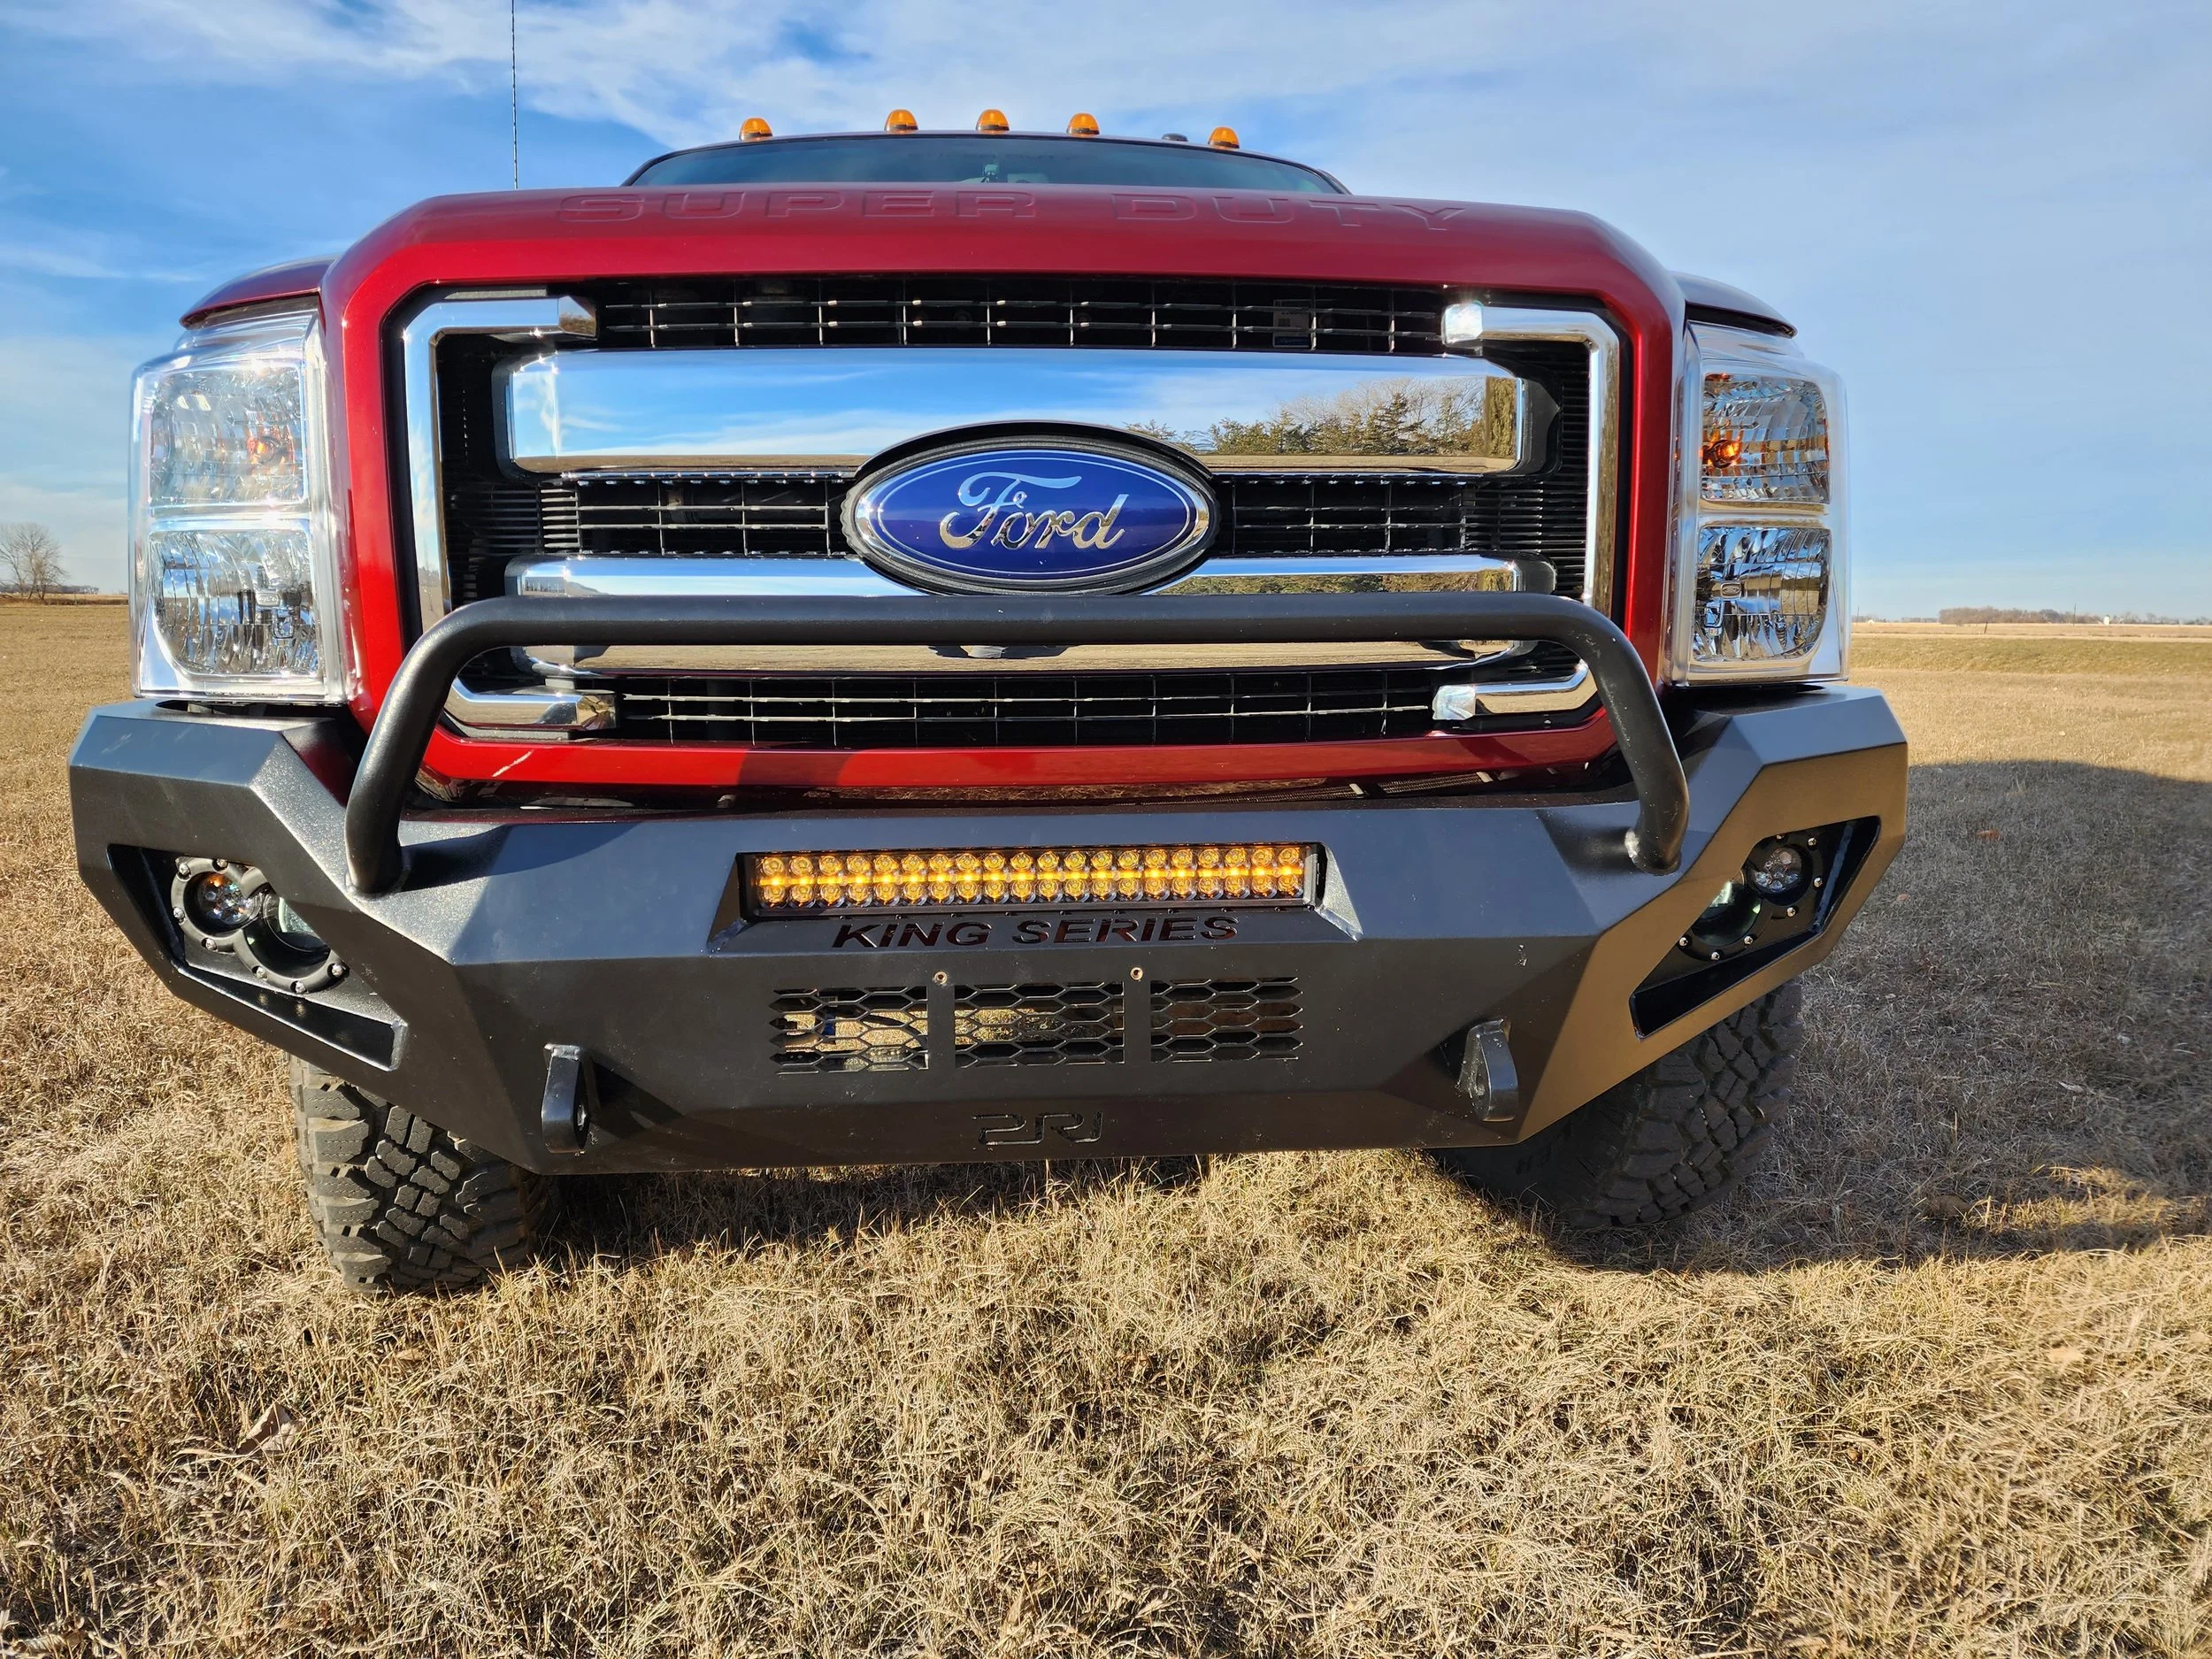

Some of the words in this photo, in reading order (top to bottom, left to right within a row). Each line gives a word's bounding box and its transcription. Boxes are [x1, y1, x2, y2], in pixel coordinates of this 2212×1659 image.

[557, 190, 1035, 222] SUPER
[1112, 193, 1465, 231] DUTY
[940, 472, 1130, 550] Ford
[832, 922, 992, 949] KING
[1011, 916, 1239, 944] SERIES
